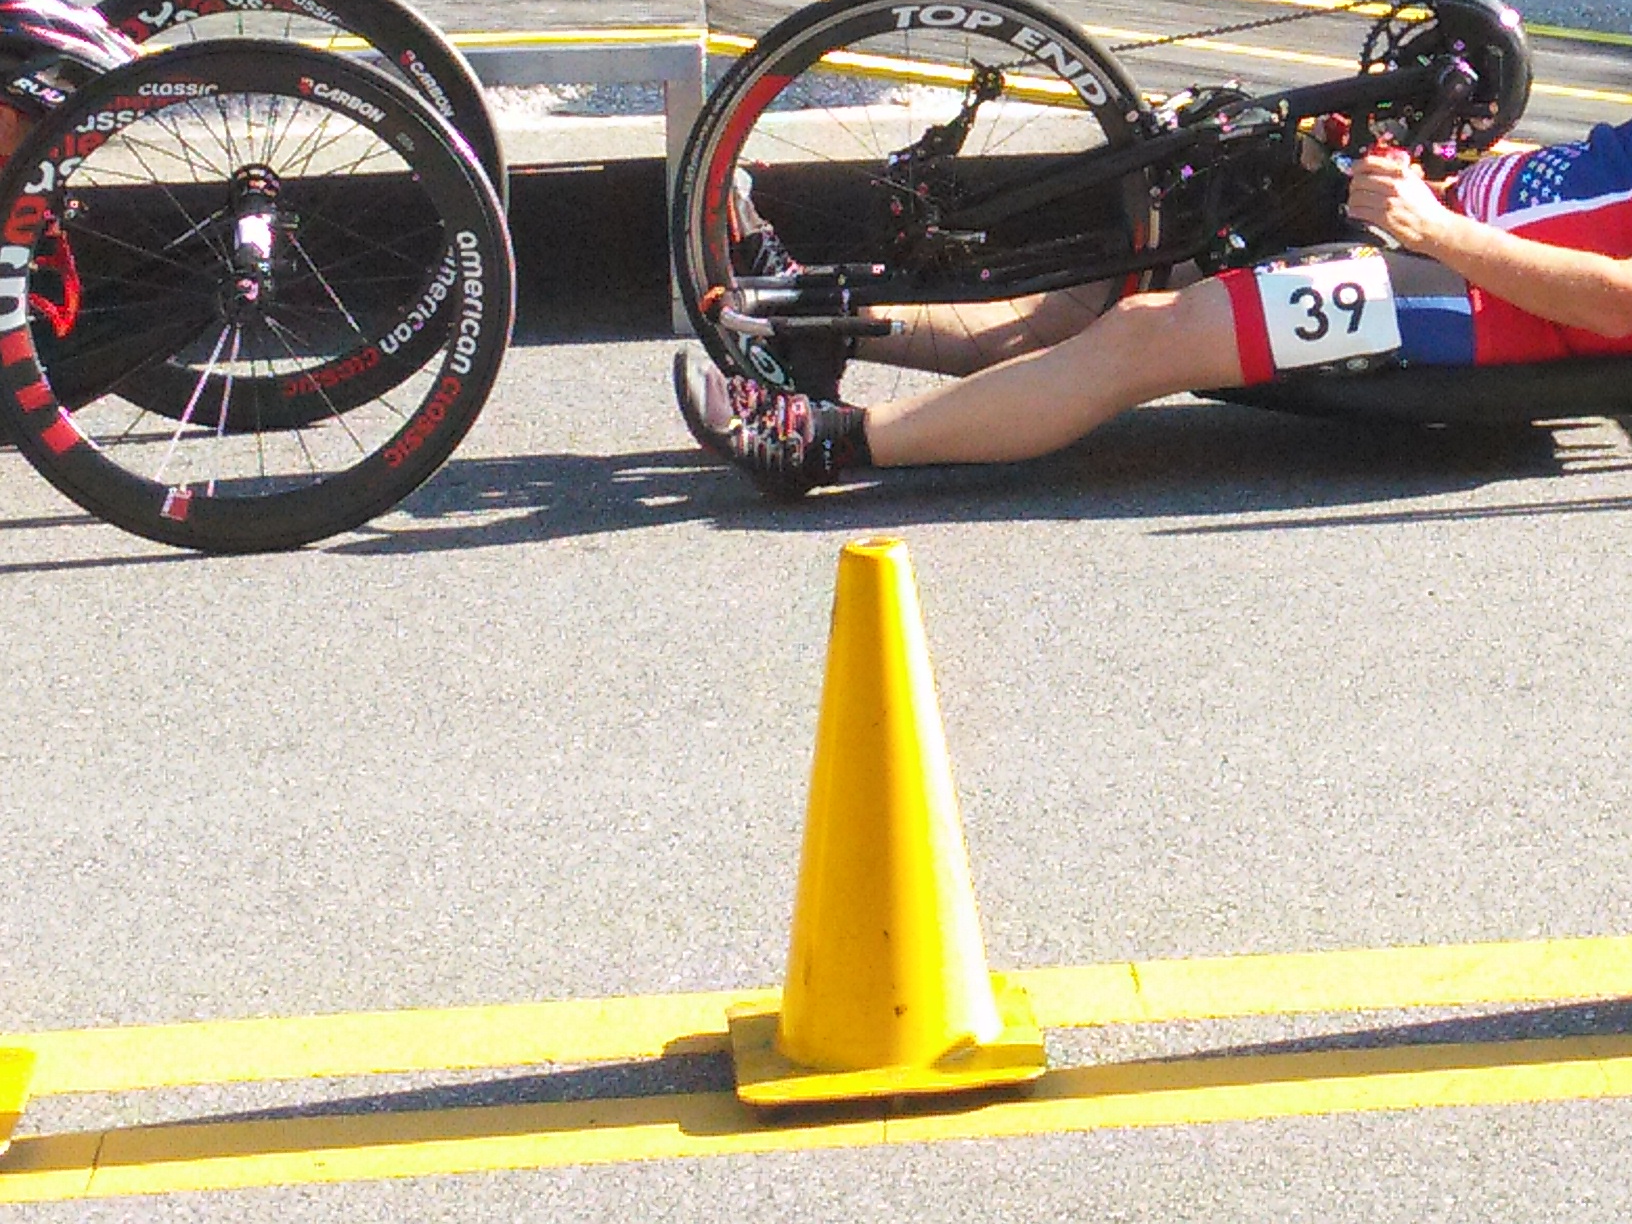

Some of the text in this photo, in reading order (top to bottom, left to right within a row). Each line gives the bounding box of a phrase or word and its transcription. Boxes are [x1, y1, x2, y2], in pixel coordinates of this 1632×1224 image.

[891, 4, 1107, 107] TOP END
[313, 82, 387, 124] CARBON
[456, 230, 484, 375] american
[1289, 281, 1366, 342] 39
